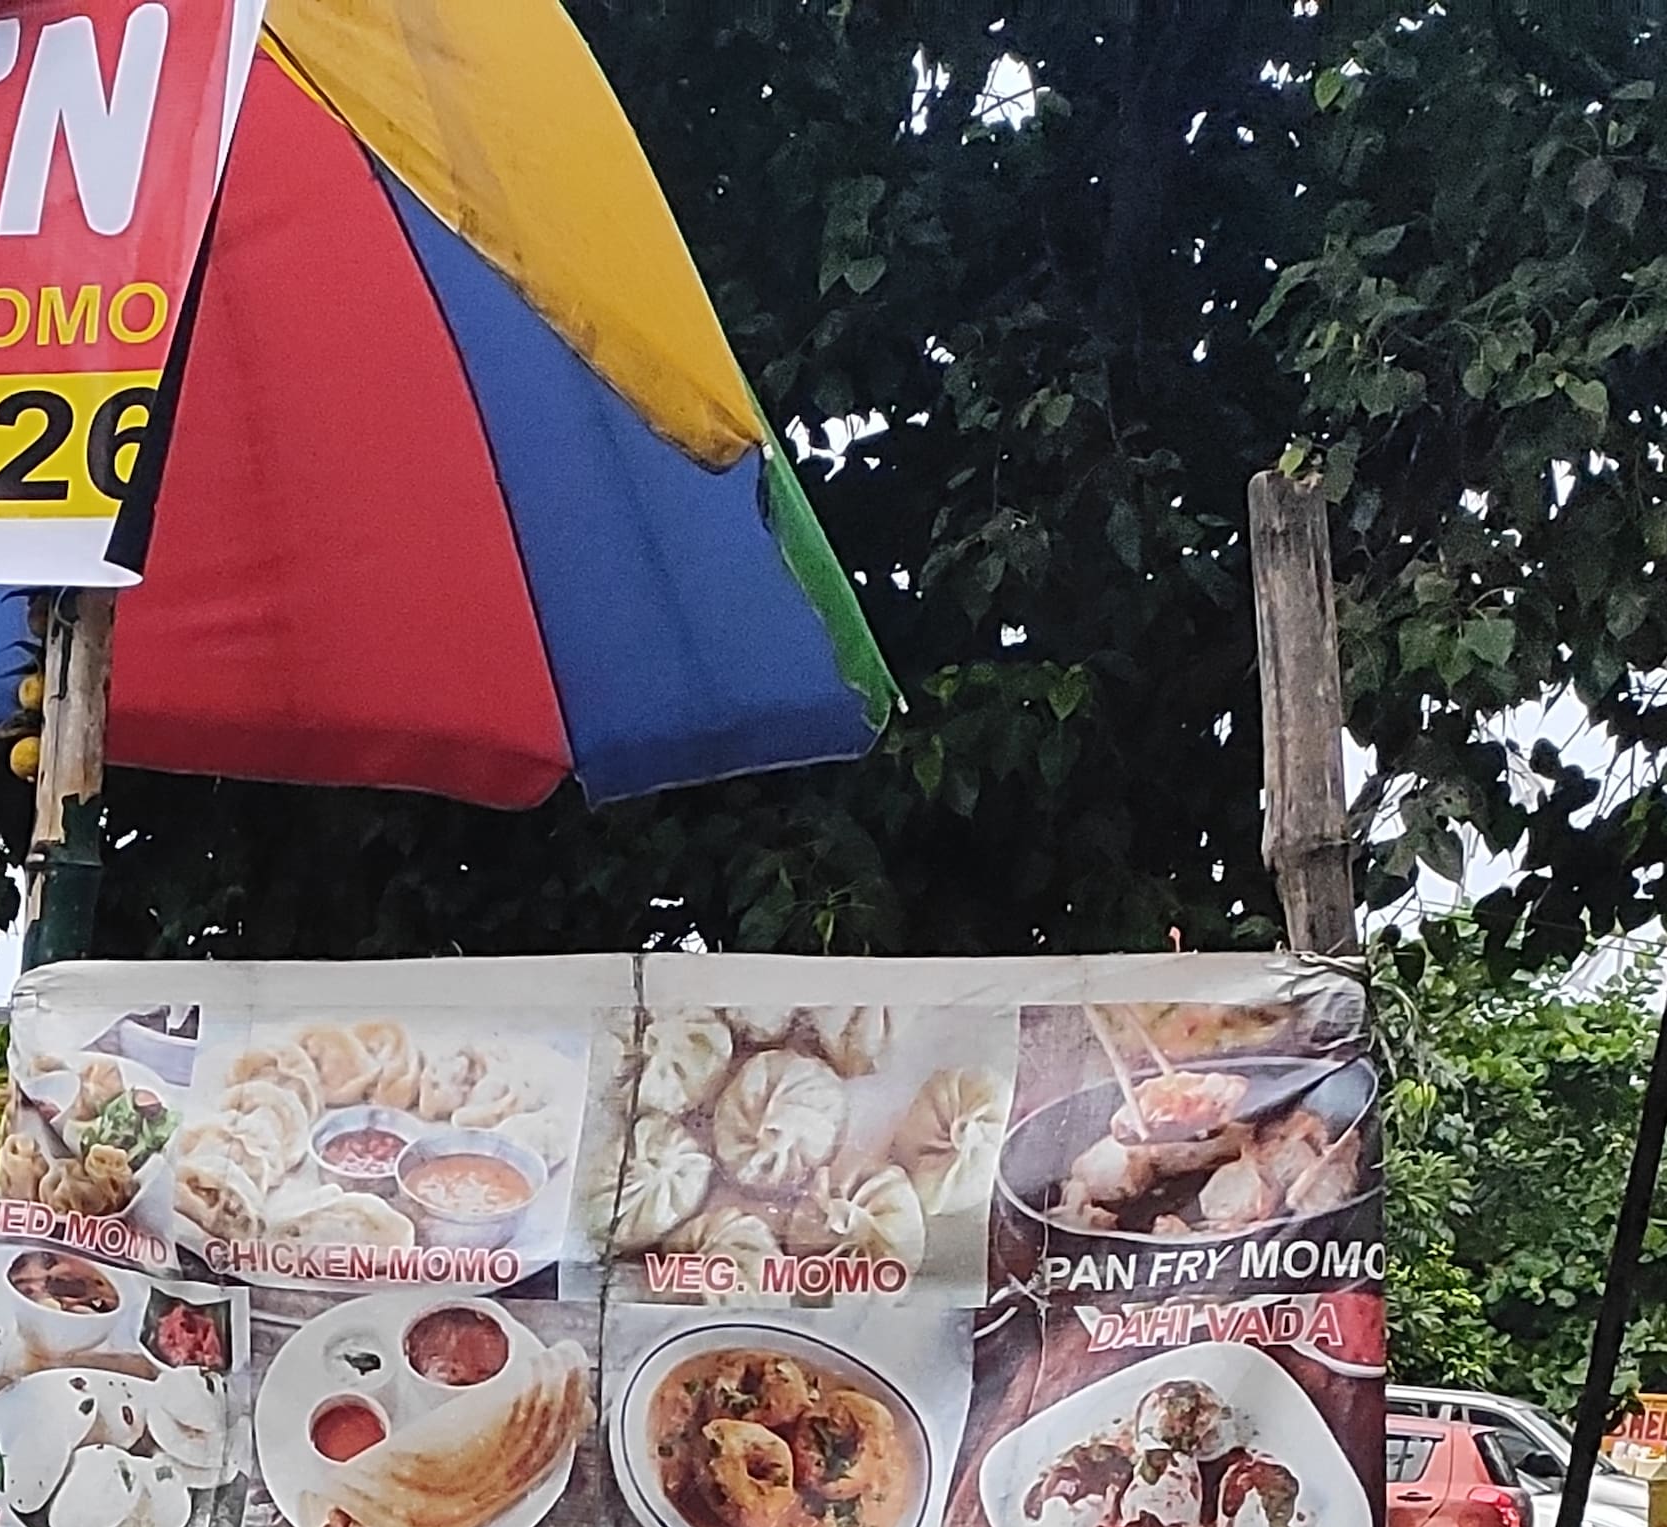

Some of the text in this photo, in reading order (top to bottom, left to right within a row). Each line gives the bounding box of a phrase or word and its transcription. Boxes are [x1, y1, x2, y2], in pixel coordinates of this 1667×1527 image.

[66, 1216, 170, 1267] MOMO
[203, 1238, 521, 1286] CHICKEN MOMO
[759, 1254, 910, 1297] MOMO
[1042, 1252, 1137, 1292] PAN
[1147, 1242, 1236, 1289] FRY
[1086, 1301, 1345, 1354] DAHI VADA
